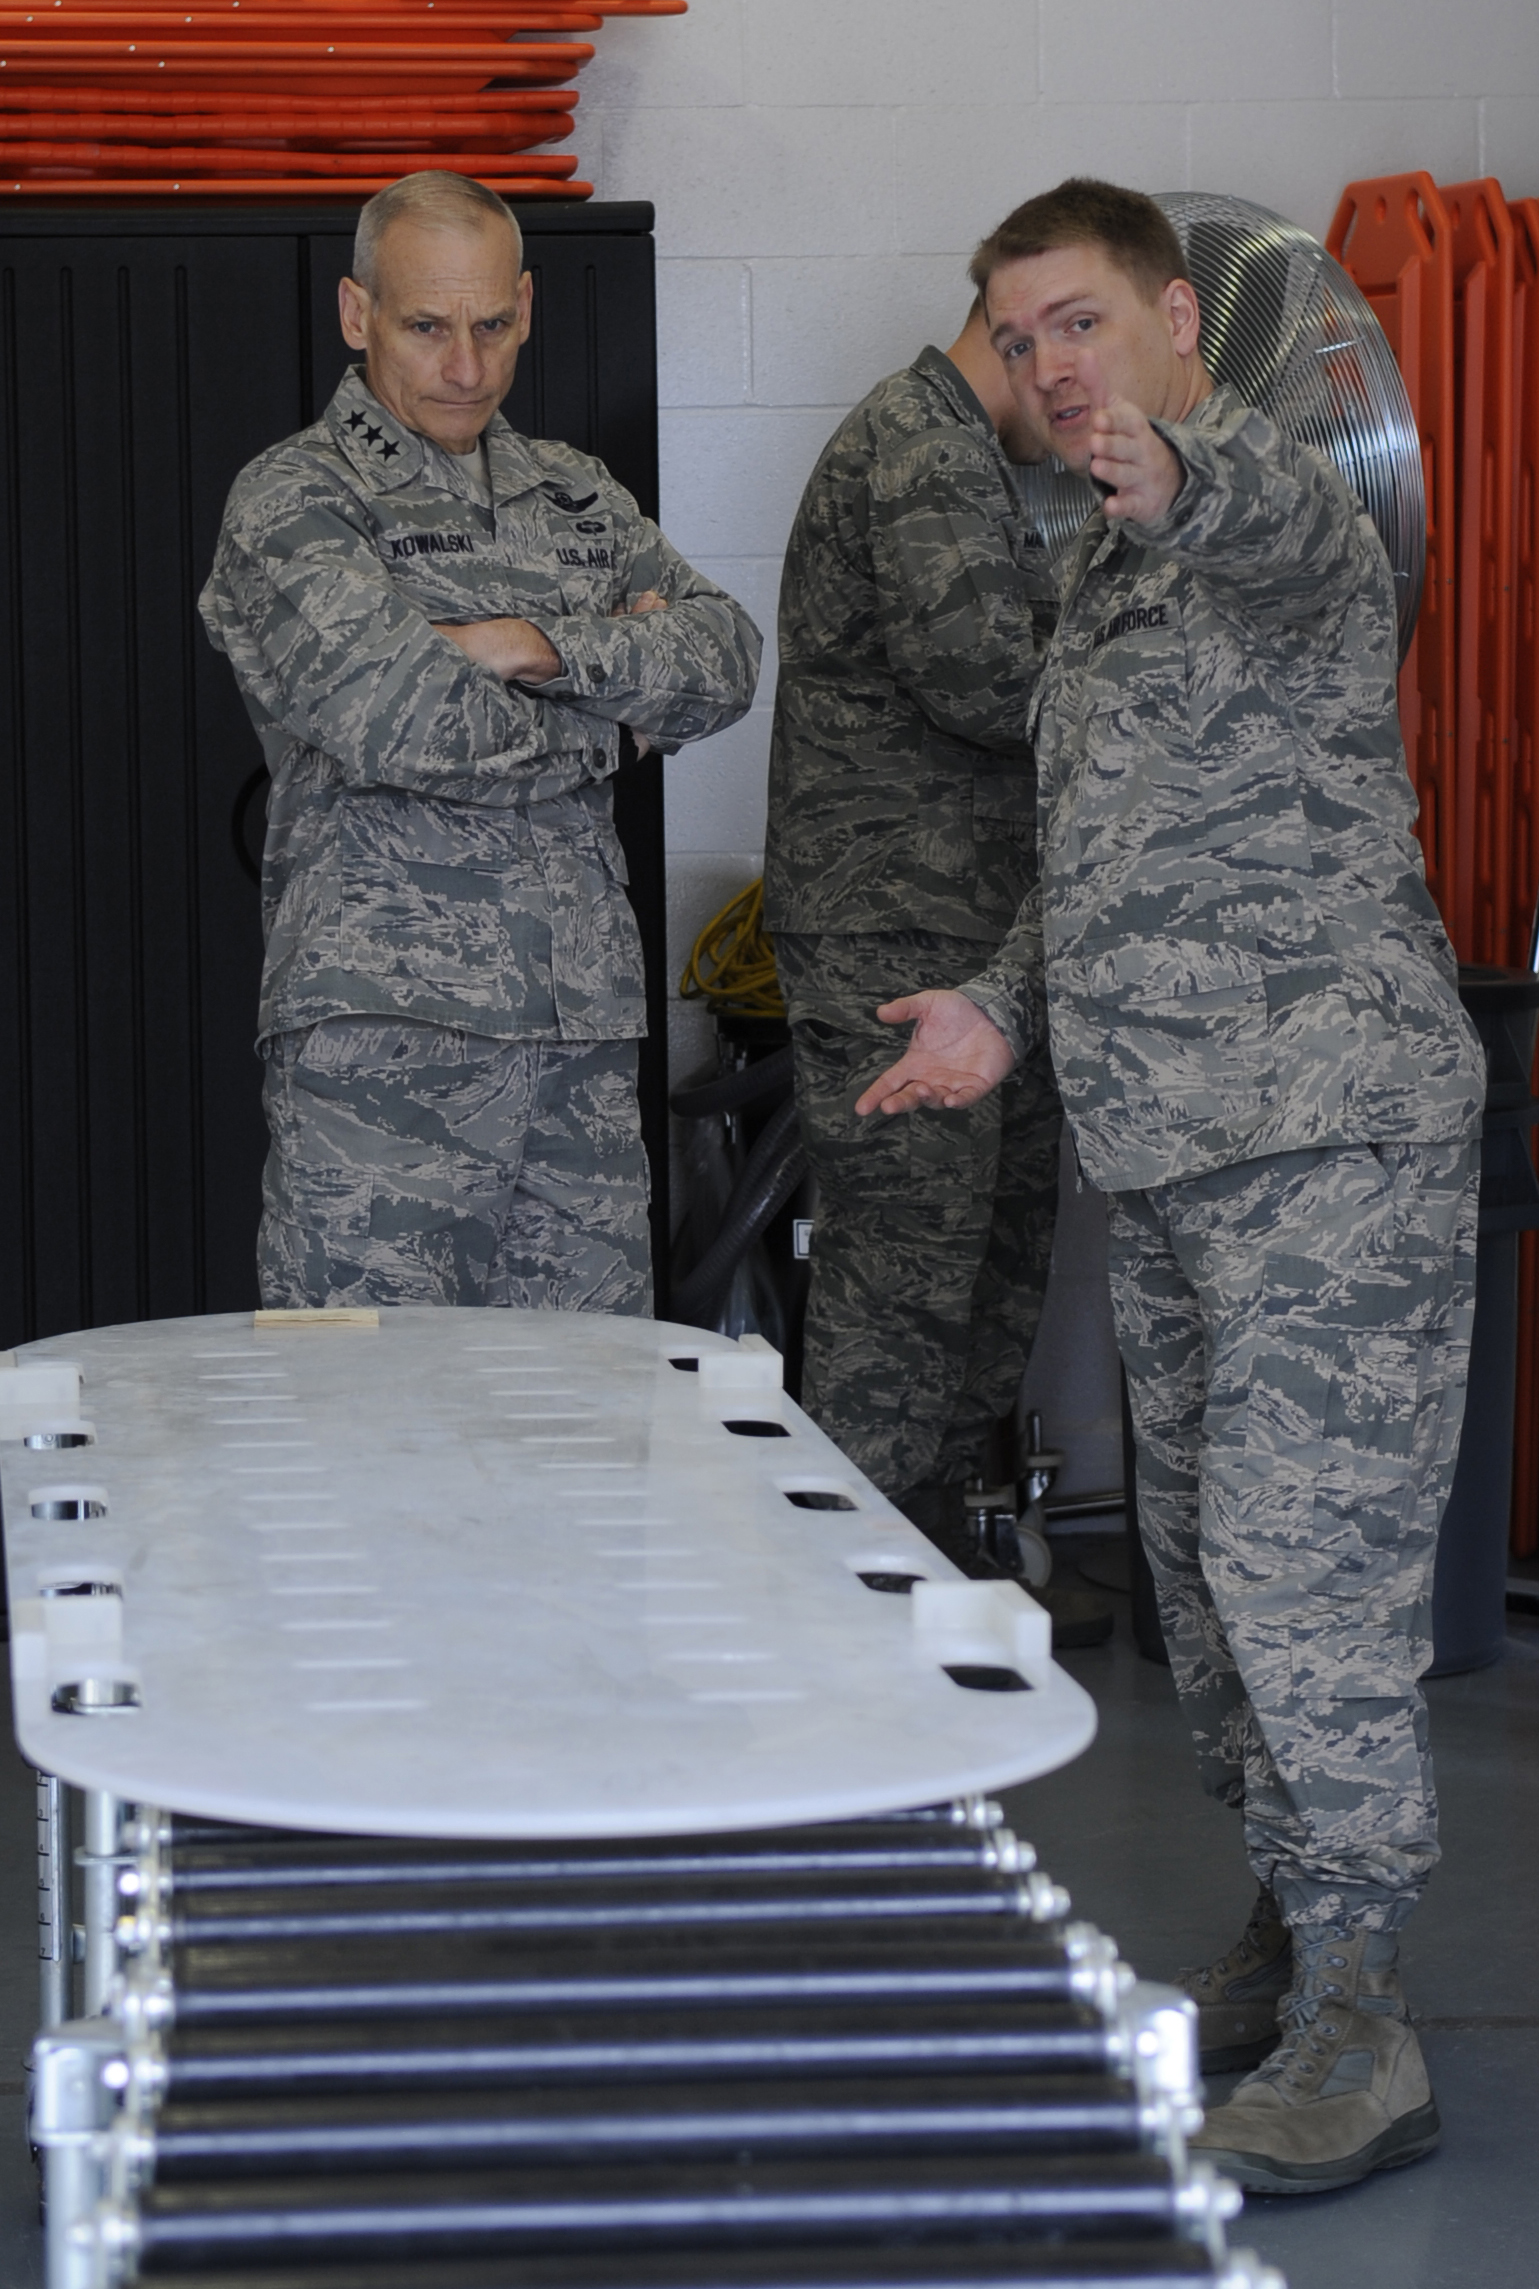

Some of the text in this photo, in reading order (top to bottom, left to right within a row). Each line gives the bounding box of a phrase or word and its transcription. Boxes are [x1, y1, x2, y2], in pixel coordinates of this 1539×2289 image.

[391, 533, 474, 559] KOWALSKI
[556, 548, 586, 566] U.S.
[588, 548, 610, 568] AIR
[1122, 603, 1168, 635] FORCE
